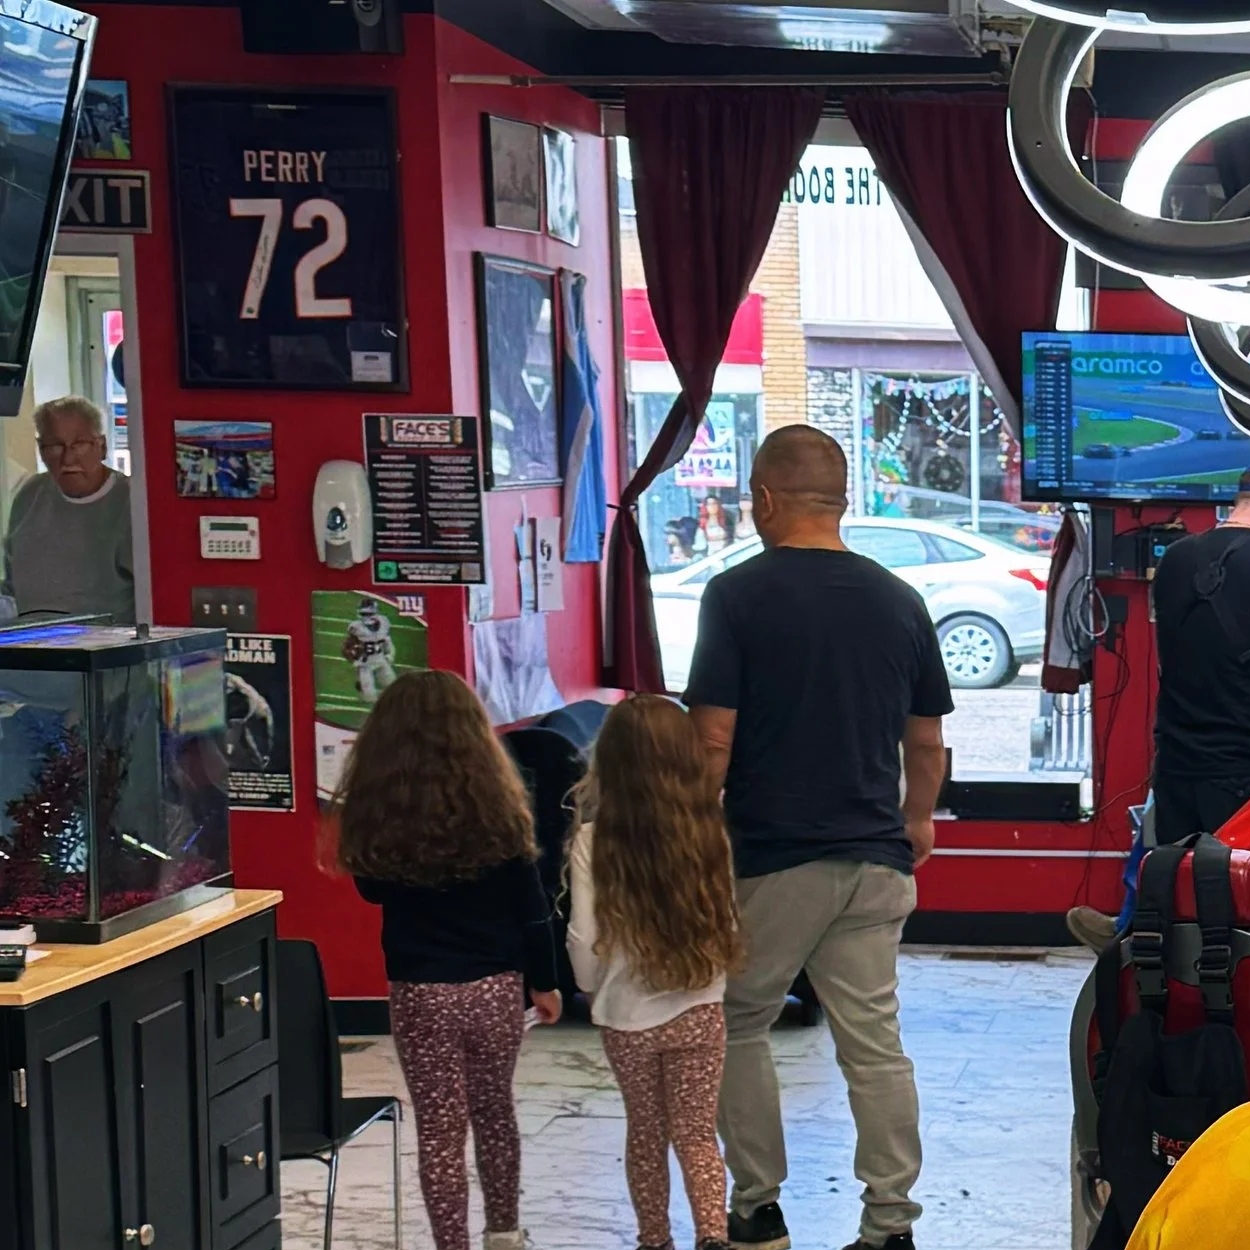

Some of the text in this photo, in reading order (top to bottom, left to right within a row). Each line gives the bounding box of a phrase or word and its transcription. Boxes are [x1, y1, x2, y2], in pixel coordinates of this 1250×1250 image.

[243, 150, 327, 183] PERRY
[60, 178, 142, 224] XIT
[229, 198, 353, 320] 72
[1072, 357, 1163, 374] aramco
[240, 639, 272, 651] LIKE
